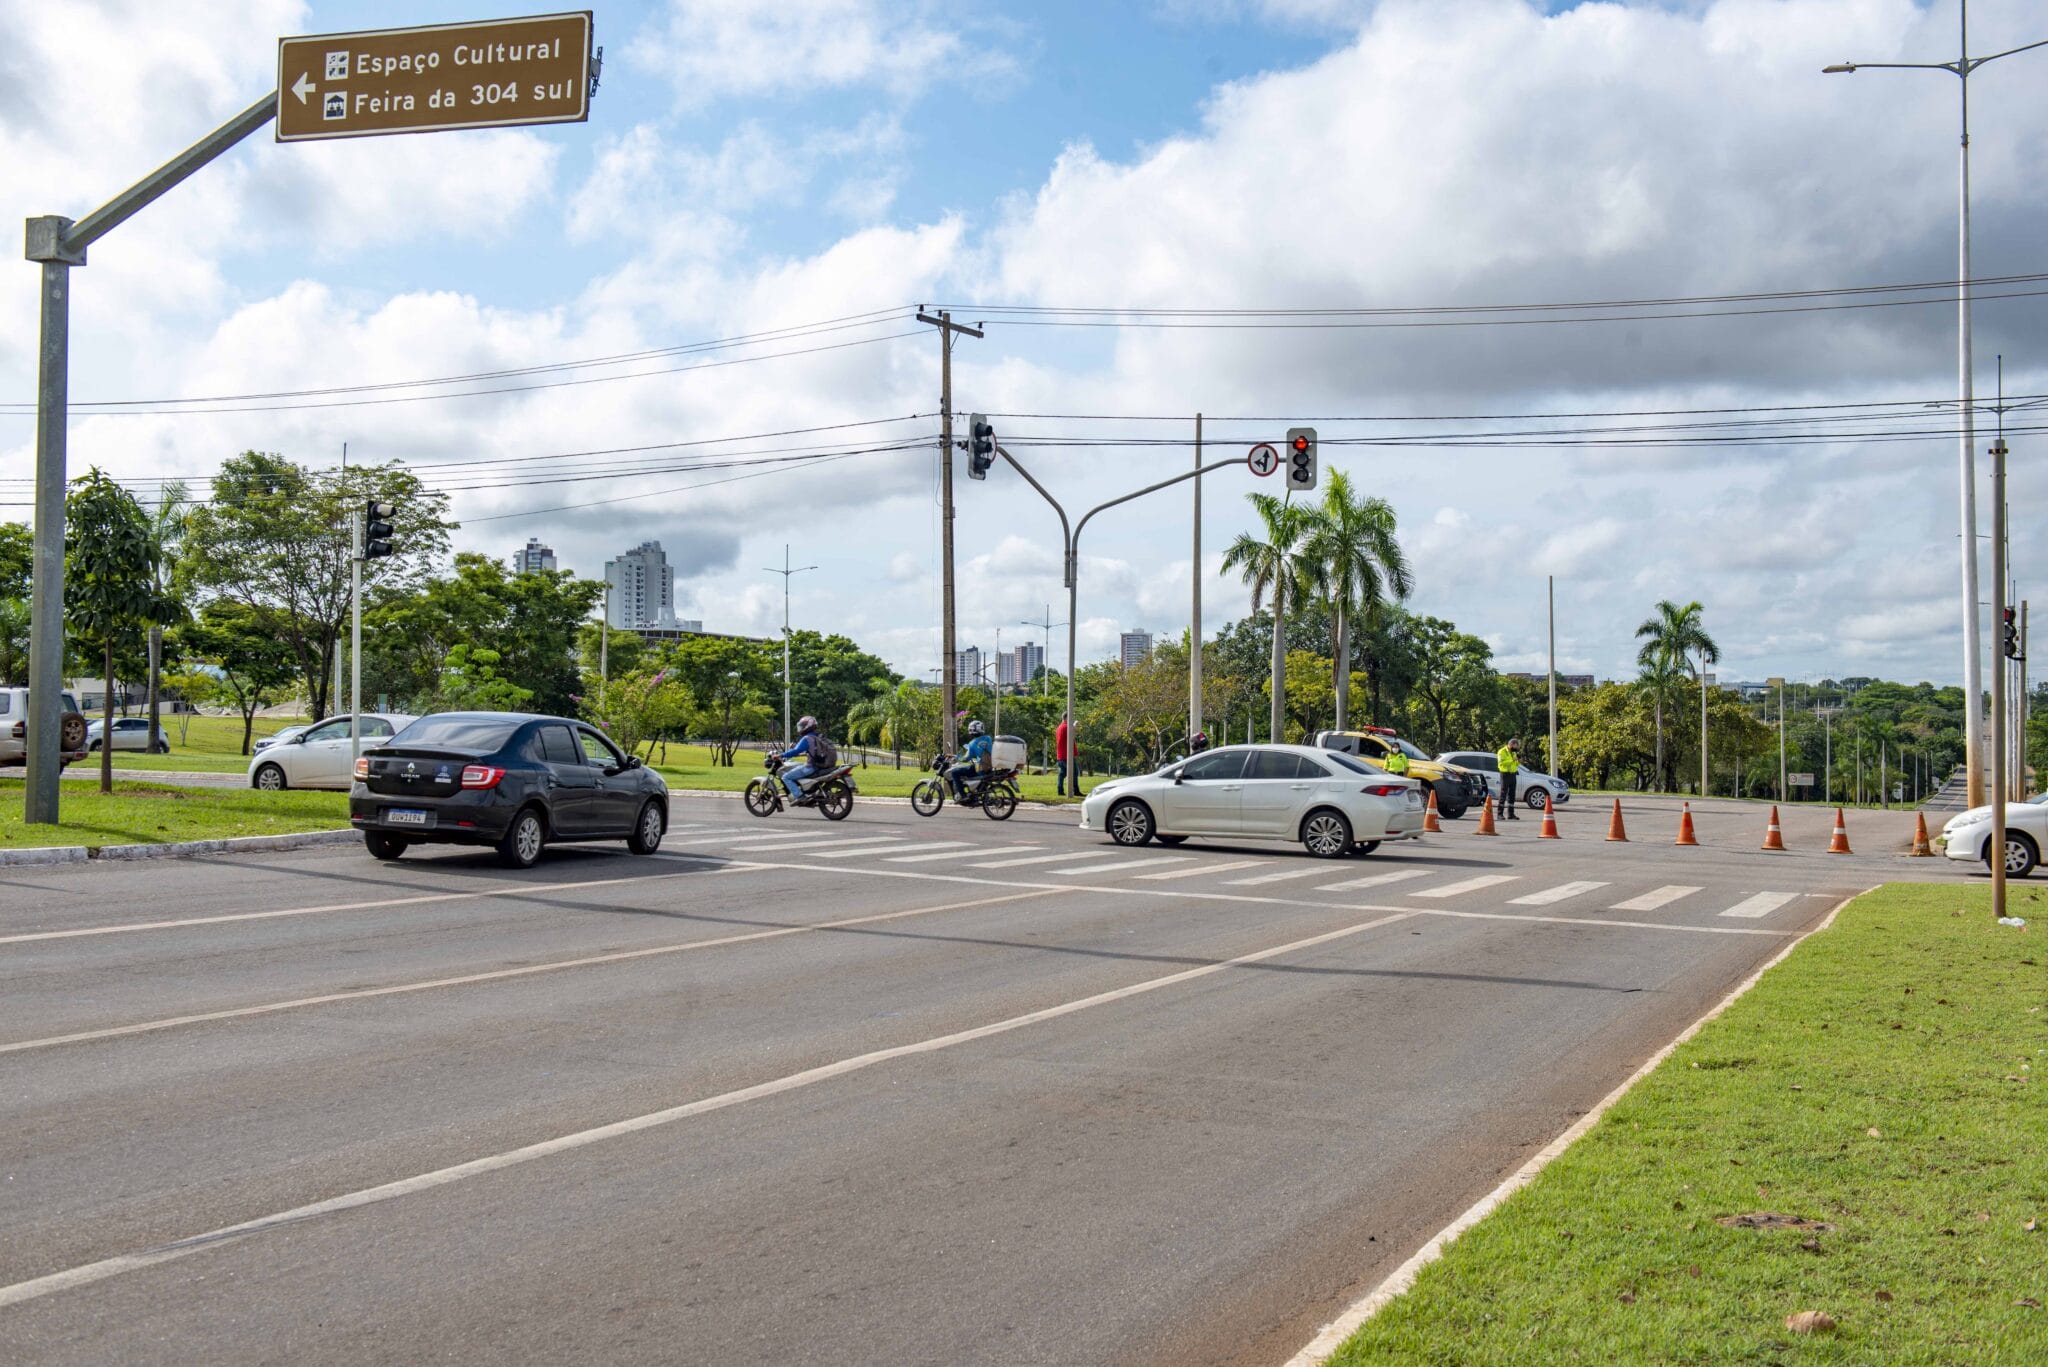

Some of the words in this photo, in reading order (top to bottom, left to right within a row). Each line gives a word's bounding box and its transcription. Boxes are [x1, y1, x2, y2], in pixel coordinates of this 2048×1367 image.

[356, 52, 440, 77] Espaço
[454, 38, 560, 66] Cultural
[355, 90, 415, 114] Feira
[428, 88, 456, 108] da
[470, 82, 518, 105] 304
[533, 79, 573, 101] sul
